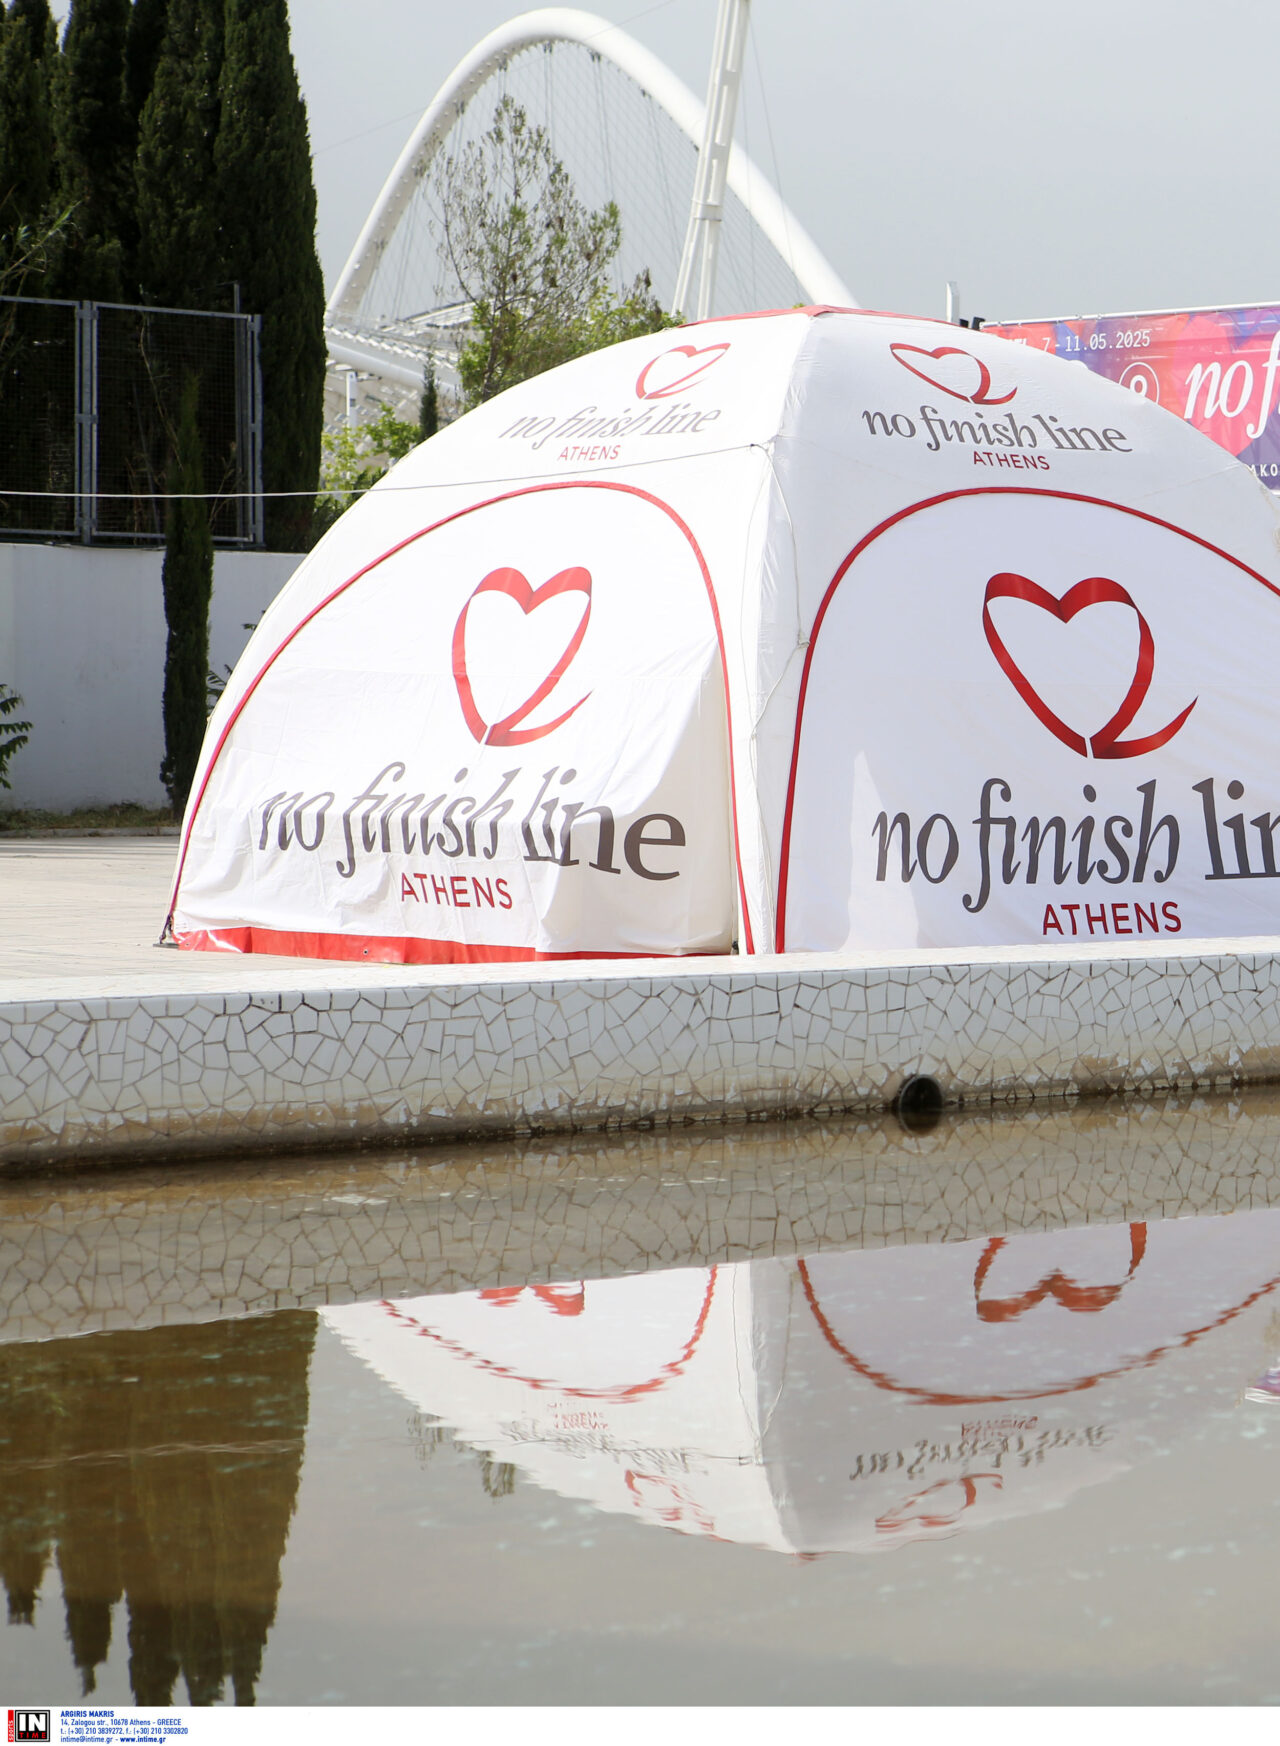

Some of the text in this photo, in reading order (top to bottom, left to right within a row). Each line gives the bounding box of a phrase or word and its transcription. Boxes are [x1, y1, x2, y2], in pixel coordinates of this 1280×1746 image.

[1184, 358, 1251, 420] no
[497, 403, 722, 450] no finish line
[862, 406, 1133, 454] no finish line
[556, 443, 621, 462] ATHENS
[972, 449, 1051, 471] ATHENS
[257, 761, 686, 881] no finish line
[870, 808, 960, 884] no
[961, 777, 1182, 914] finish
[399, 870, 513, 910] ATHENS
[1041, 901, 1182, 937] ATHENS
